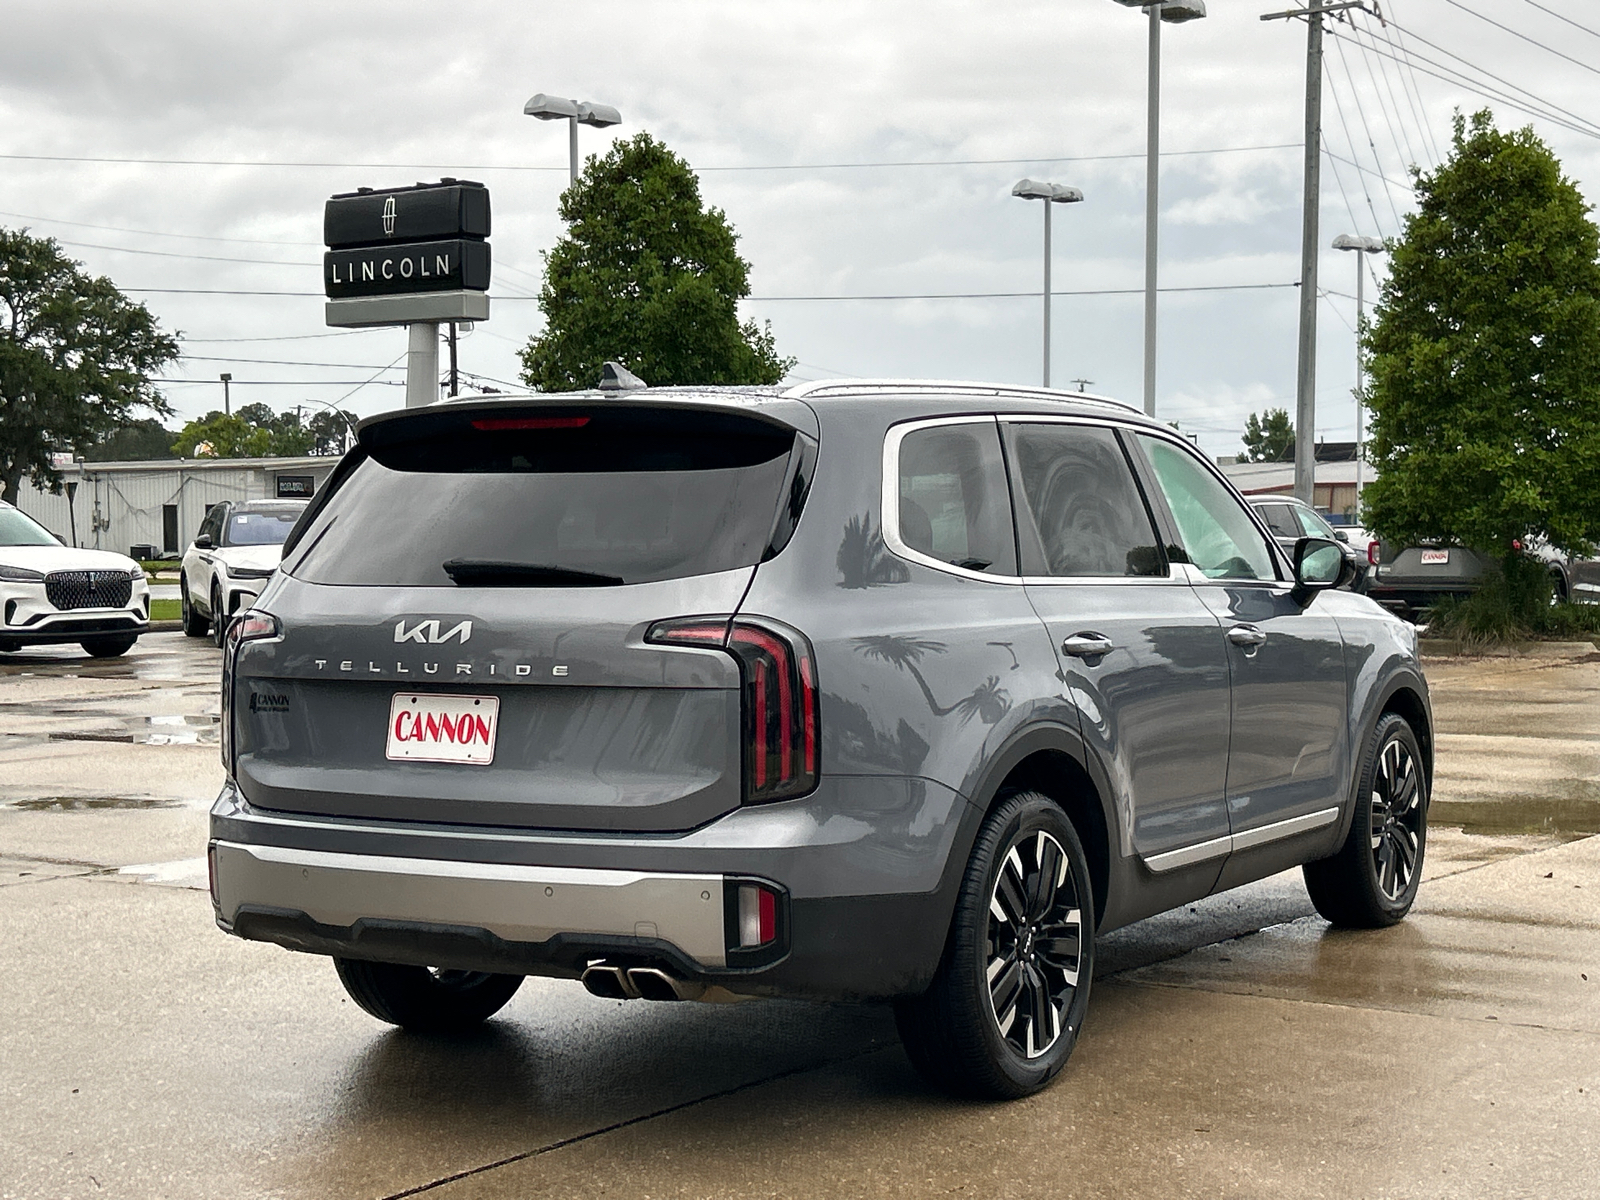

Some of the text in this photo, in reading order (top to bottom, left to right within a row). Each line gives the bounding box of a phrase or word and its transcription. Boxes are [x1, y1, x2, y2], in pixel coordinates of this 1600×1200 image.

[332, 254, 450, 284] LINCOLN
[394, 619, 472, 645] KIA
[315, 659, 569, 677] TELLURIDE
[257, 694, 290, 705] CANNON
[394, 710, 492, 746] CANNON
